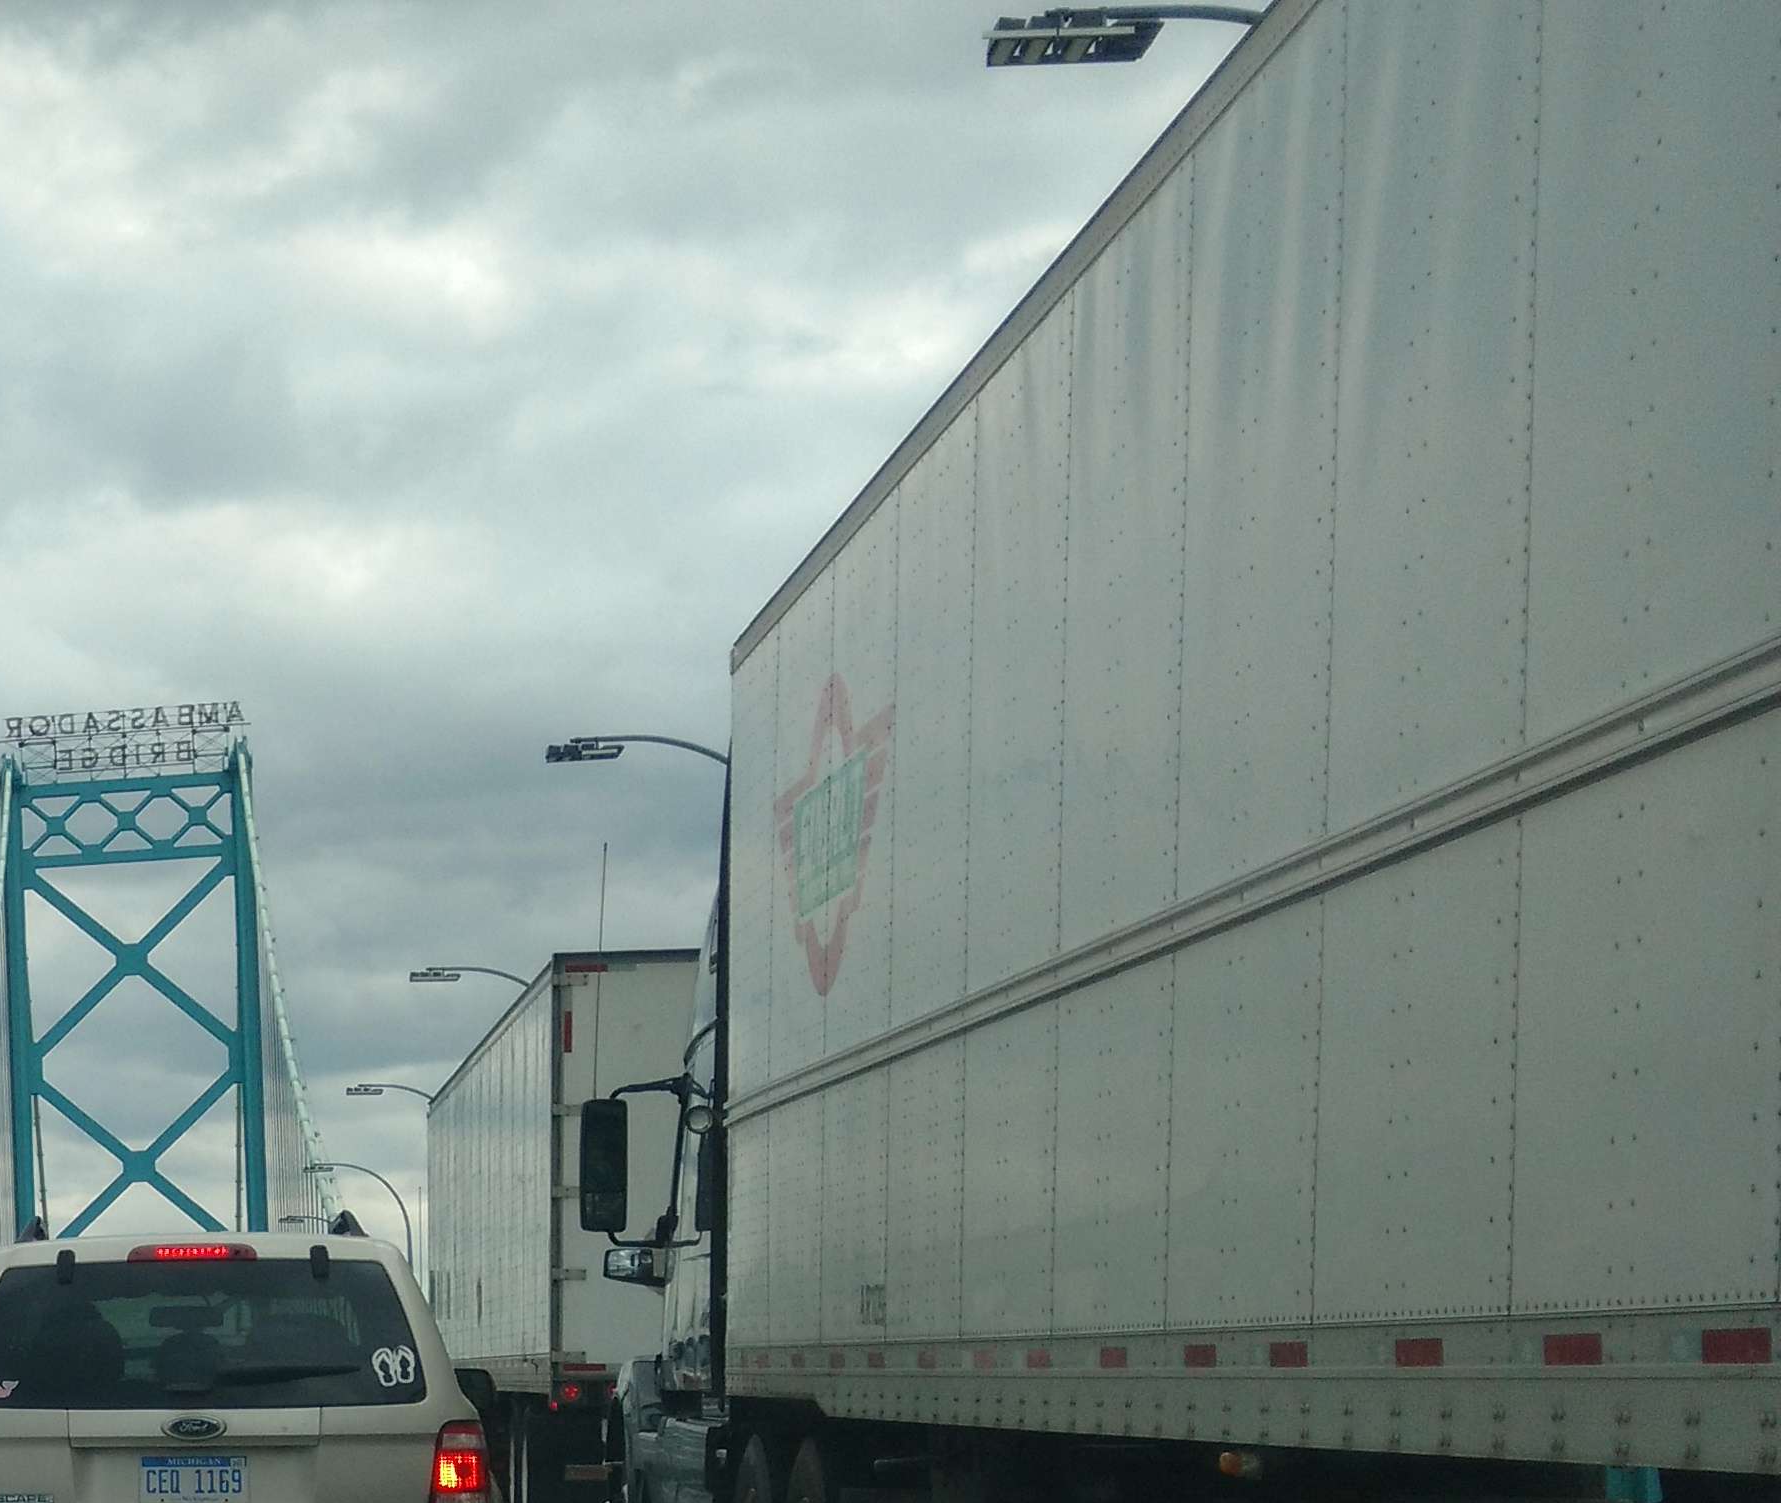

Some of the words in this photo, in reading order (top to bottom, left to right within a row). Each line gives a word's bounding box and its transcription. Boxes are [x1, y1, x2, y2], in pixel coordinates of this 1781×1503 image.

[167, 1457, 221, 1466] MICHIGAN
[146, 1469, 180, 1494] CEQ
[195, 1469, 242, 1494] 1169
